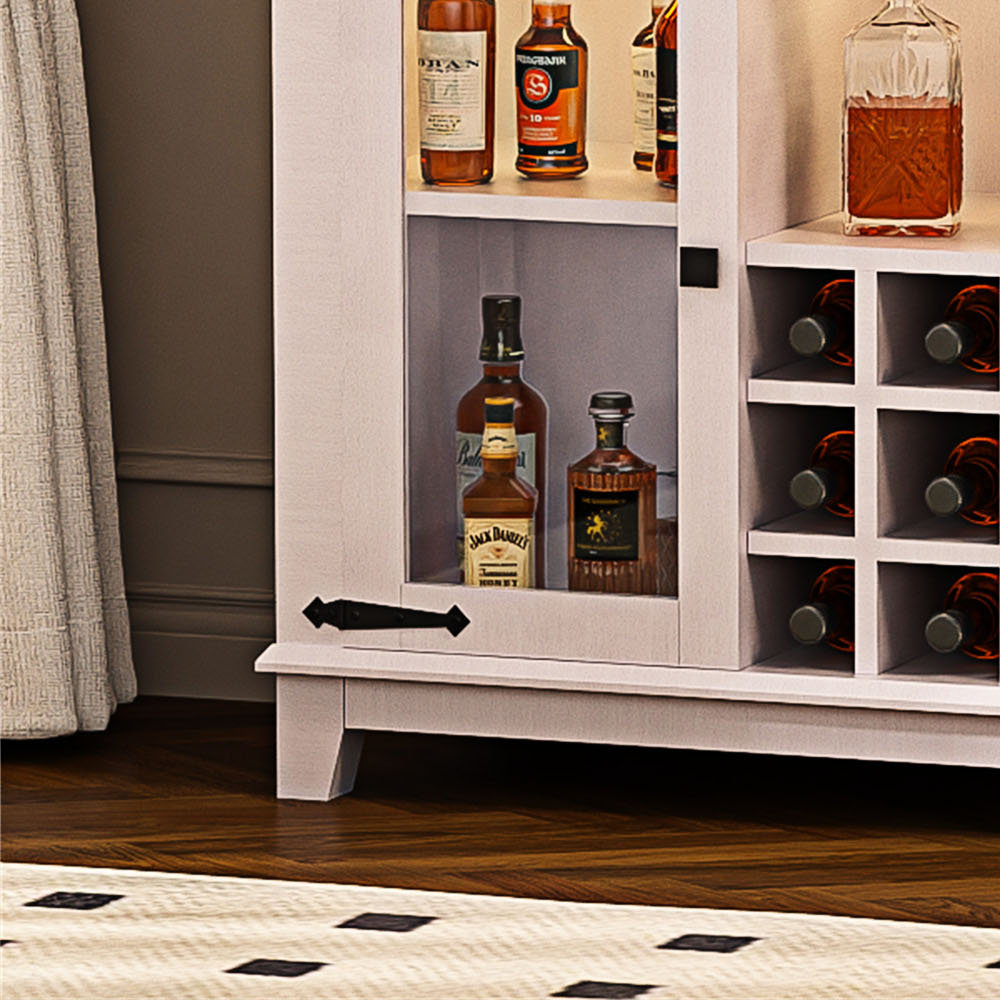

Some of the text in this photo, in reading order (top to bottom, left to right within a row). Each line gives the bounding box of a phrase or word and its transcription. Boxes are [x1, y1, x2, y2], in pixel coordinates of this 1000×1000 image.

[530, 114, 543, 123] 10
[469, 526, 530, 551] JACK DANIEL'S
